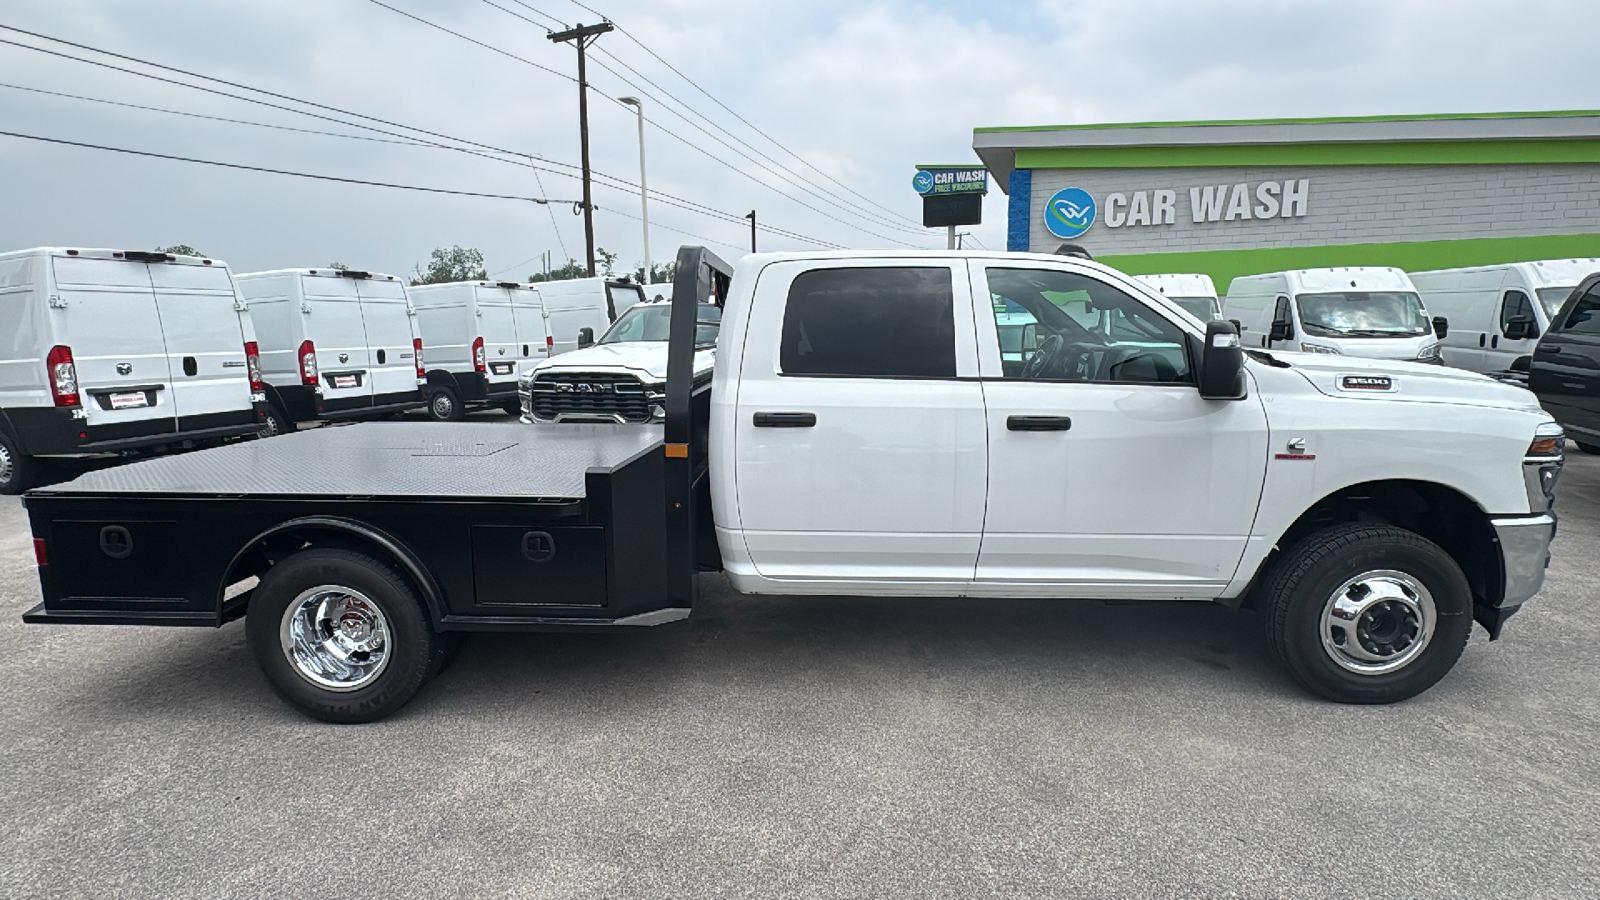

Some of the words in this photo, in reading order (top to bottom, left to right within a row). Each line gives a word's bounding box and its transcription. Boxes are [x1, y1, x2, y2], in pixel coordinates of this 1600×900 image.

[935, 173, 953, 184] CAR
[956, 171, 985, 182] WASH
[935, 184, 951, 192] FREE
[1104, 189, 1177, 228] CAR
[1190, 179, 1310, 223] WASH
[556, 383, 613, 393] RAM
